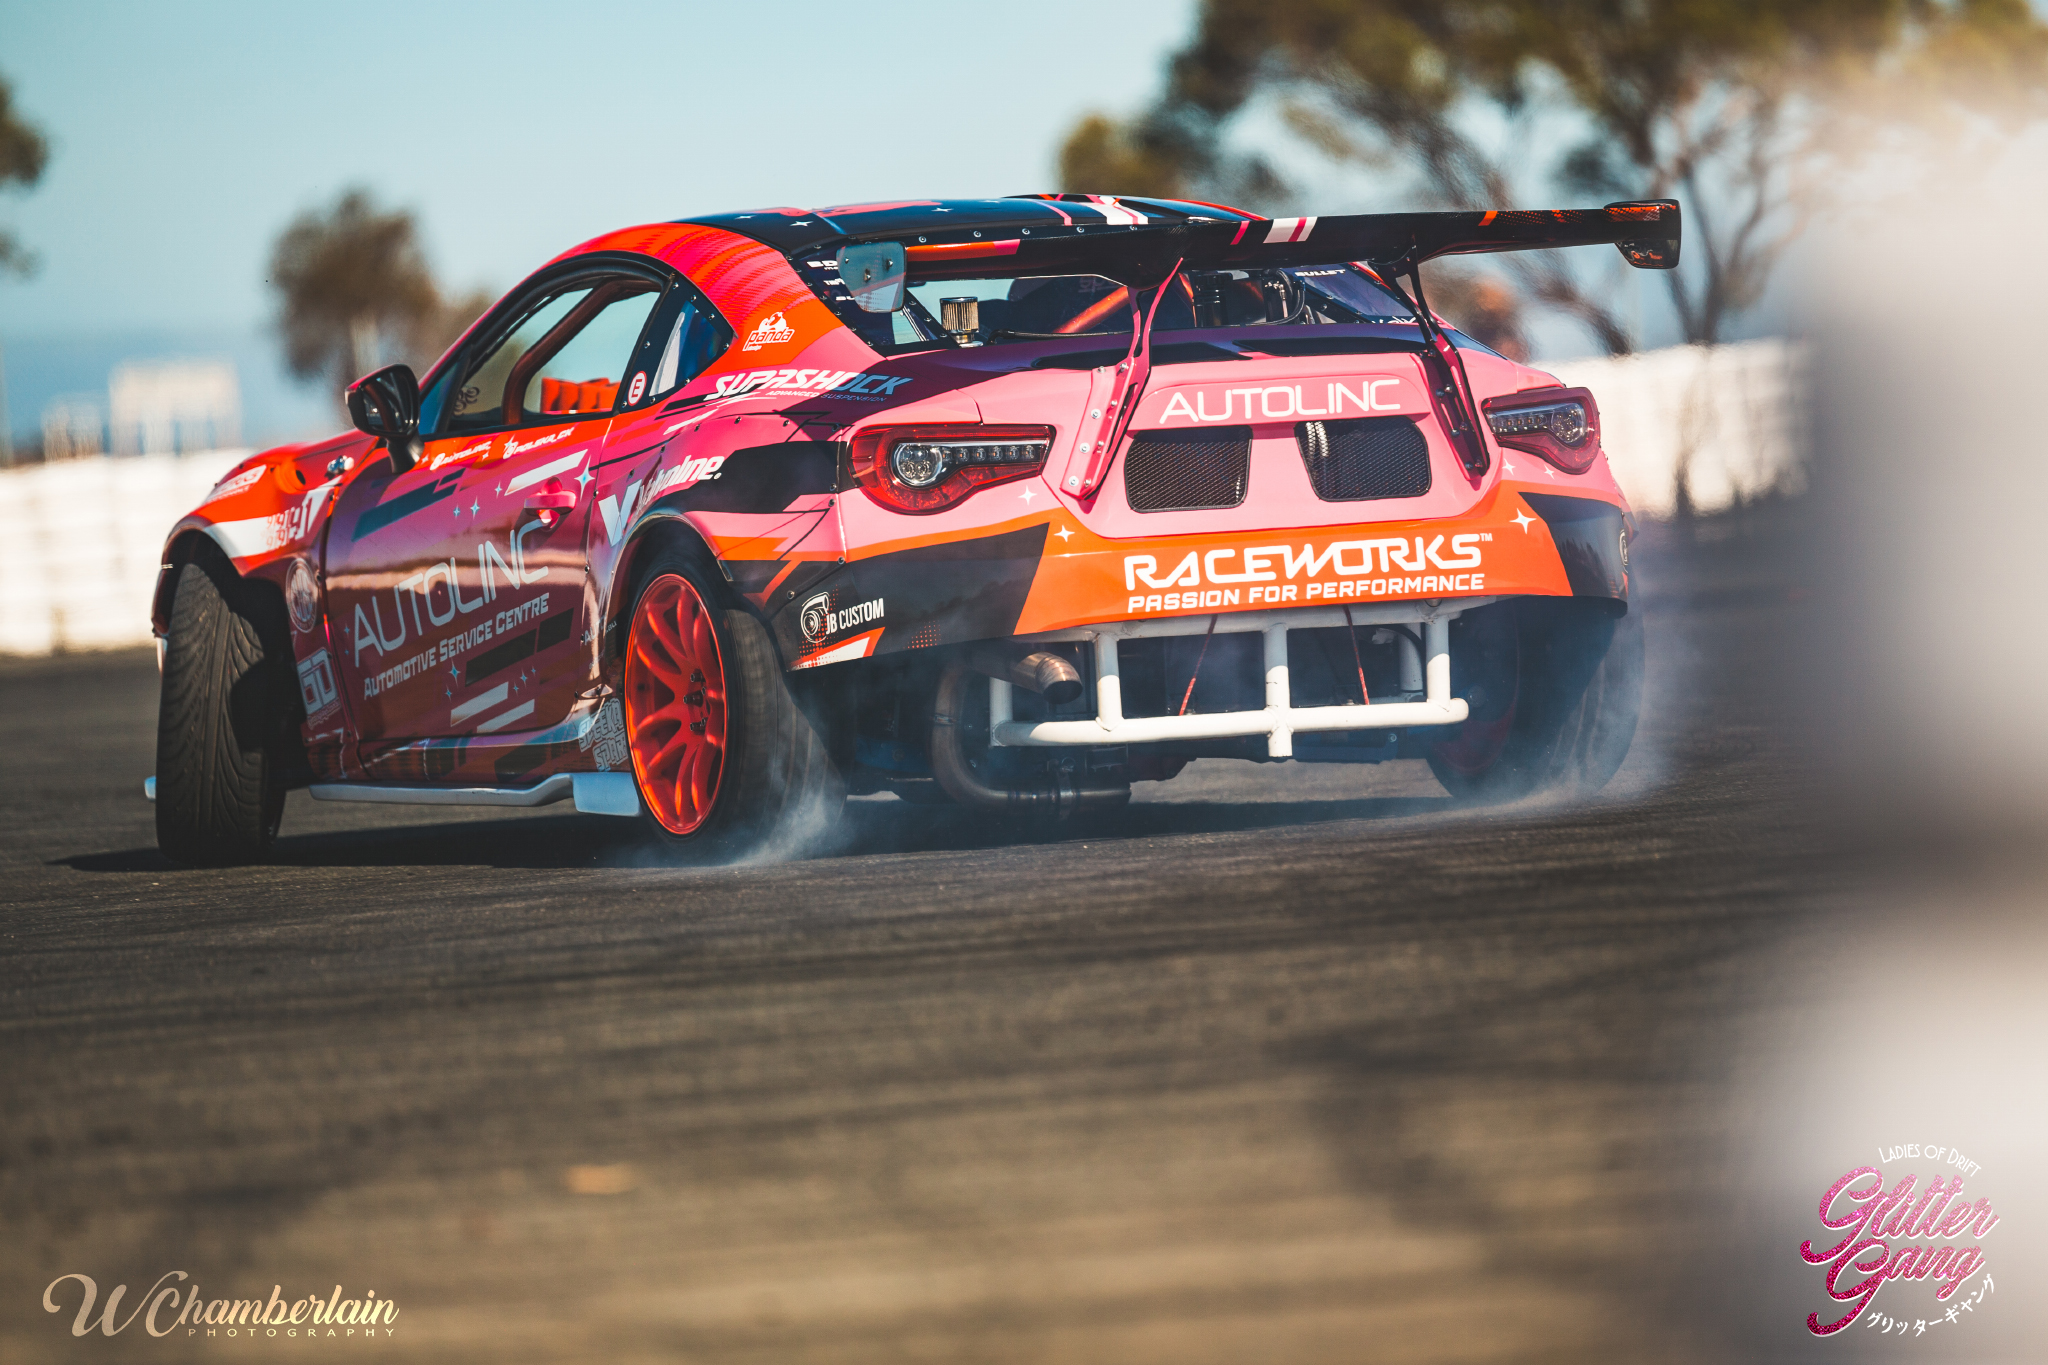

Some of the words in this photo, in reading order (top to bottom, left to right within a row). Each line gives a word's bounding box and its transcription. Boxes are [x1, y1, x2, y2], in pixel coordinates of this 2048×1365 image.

[1294, 268, 1346, 277] BULLET
[742, 327, 795, 351] panda
[764, 390, 820, 398] ADVANCED
[820, 393, 887, 403] SUSPENSION
[1158, 378, 1401, 425] AUTOLINC
[1123, 534, 1482, 591] RACEWORKS
[354, 518, 549, 668] AUTOLINC
[1127, 588, 1240, 613] PASSION
[1248, 584, 1297, 604] FOR
[1306, 573, 1486, 600] PERFORMANCE
[439, 619, 493, 662] SERVICE
[495, 592, 550, 635] CENTRE
[825, 612, 838, 635] JB
[838, 597, 885, 630] CUSTOM
